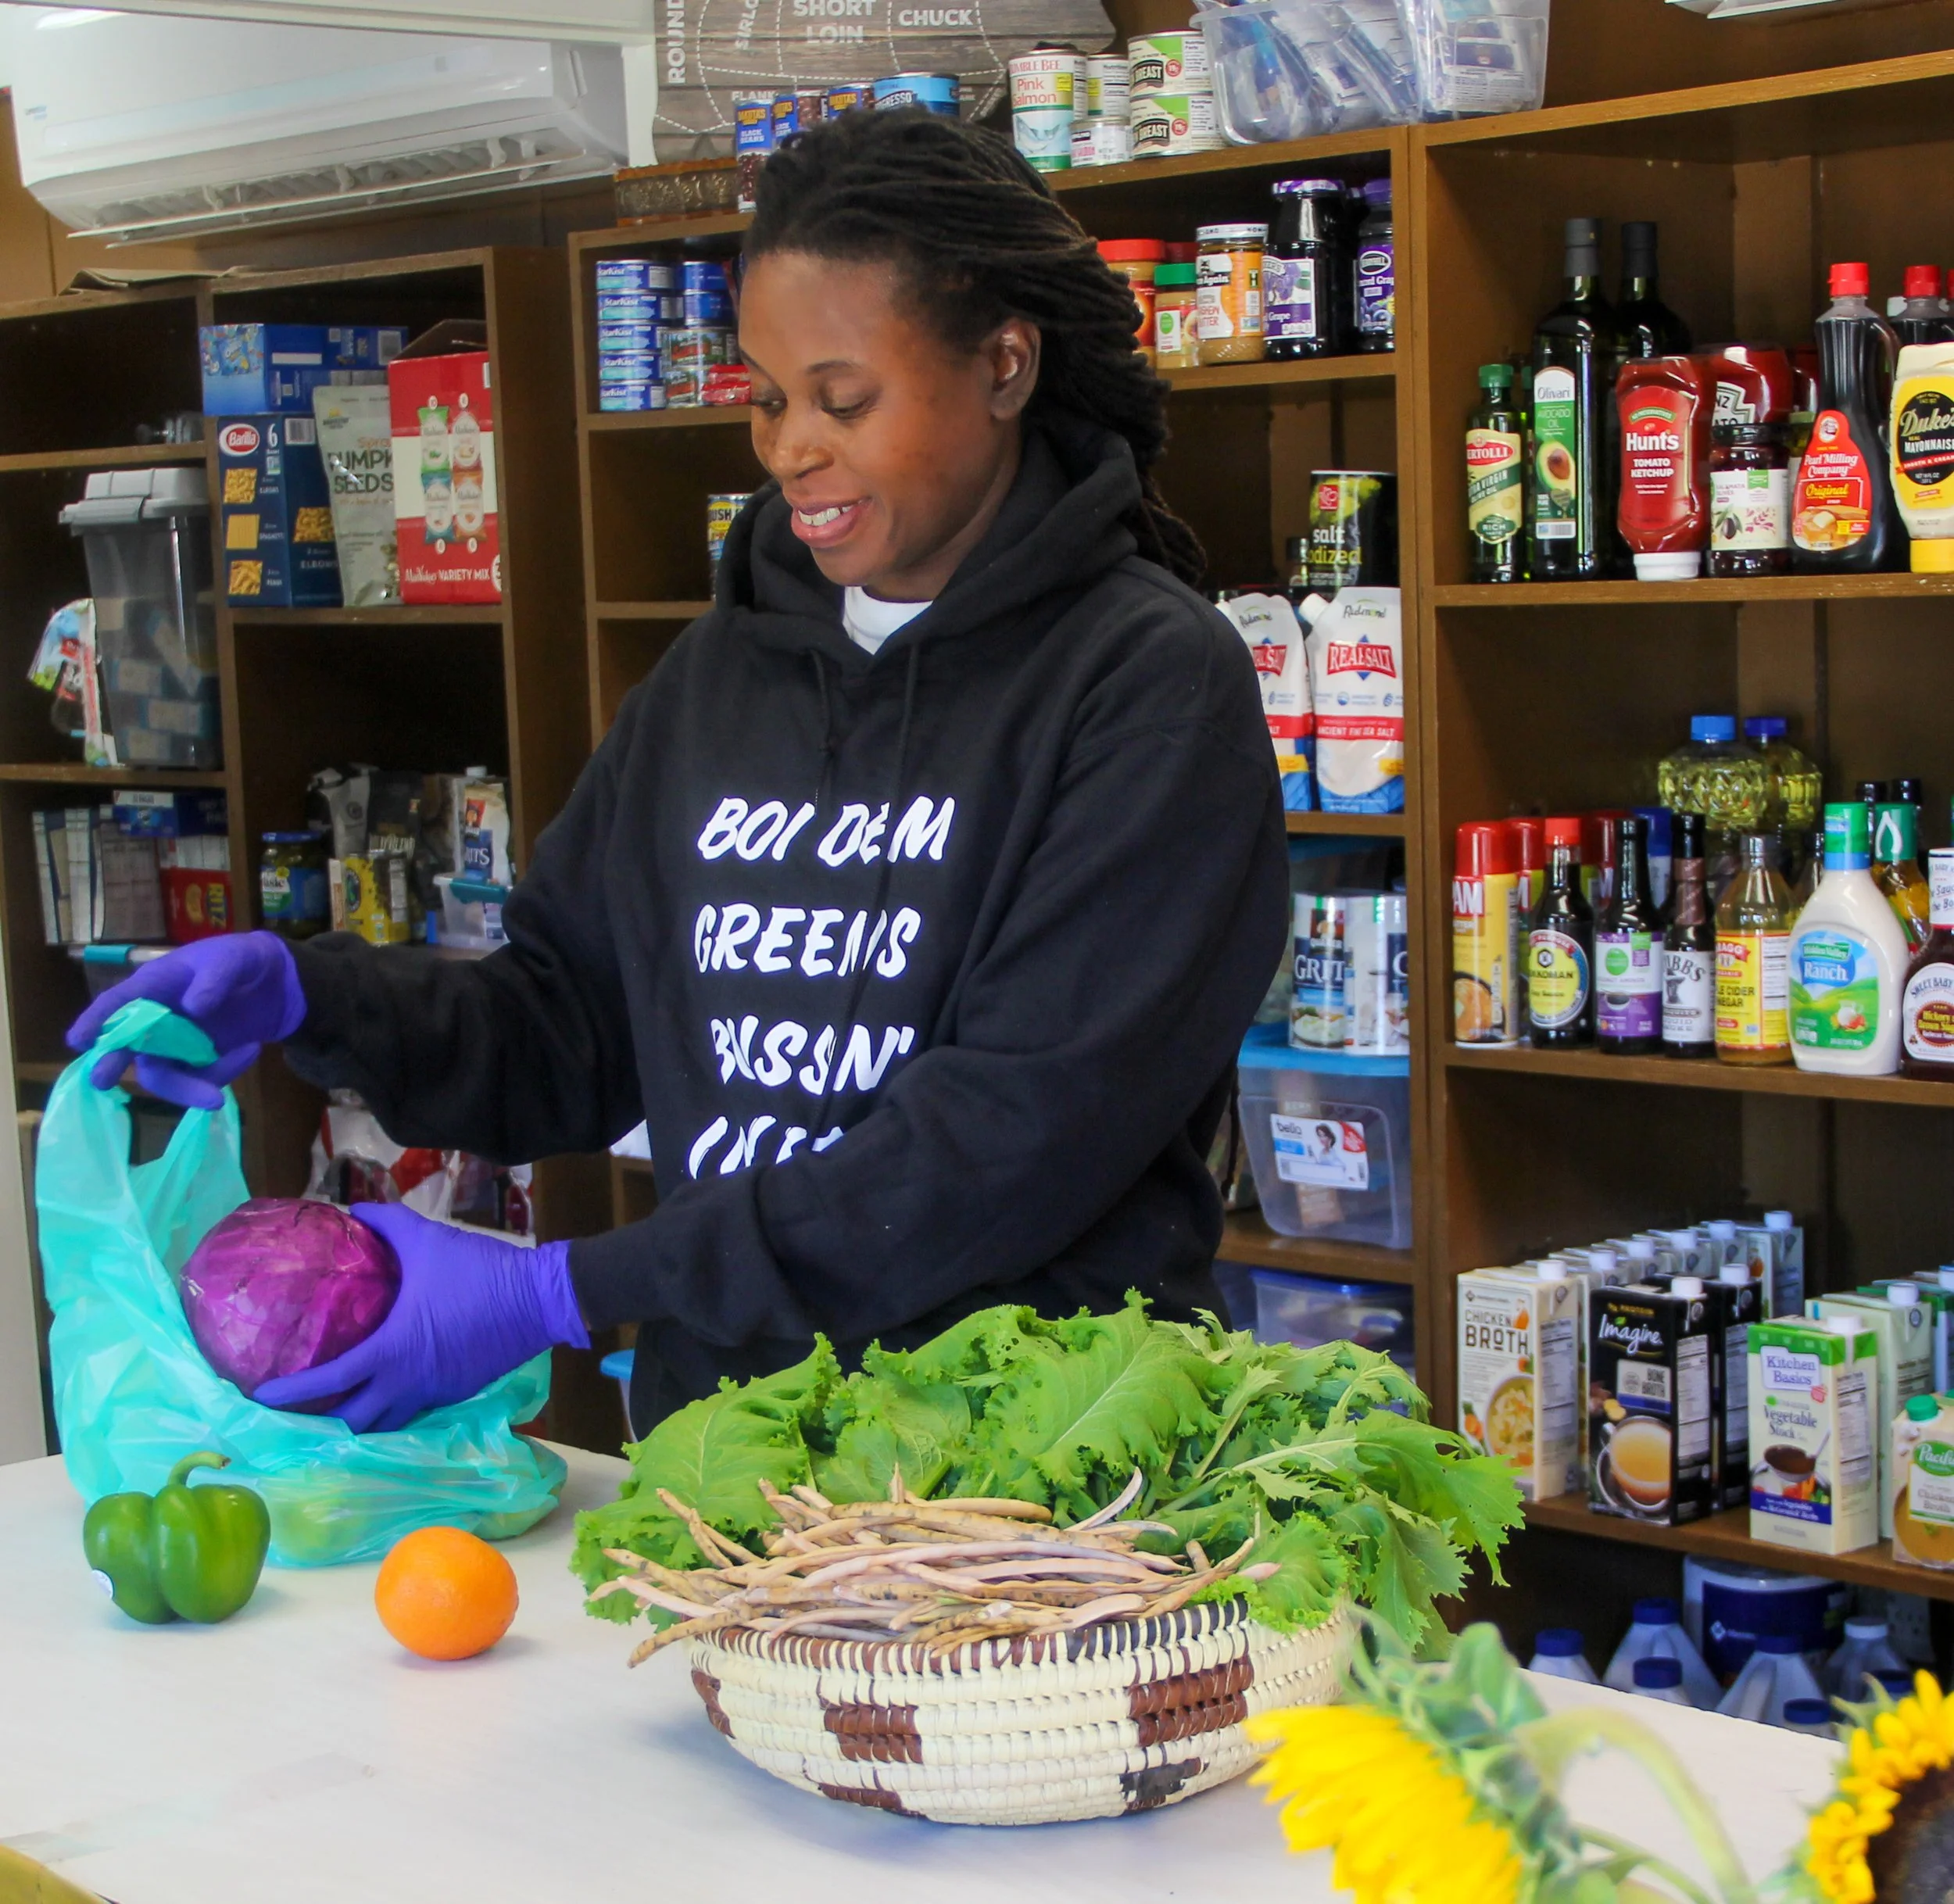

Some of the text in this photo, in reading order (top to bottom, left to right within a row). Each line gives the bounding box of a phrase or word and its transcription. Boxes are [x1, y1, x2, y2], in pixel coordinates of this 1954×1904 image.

[793, 0, 876, 16] SHORT
[898, 9, 975, 27] CHUCK
[807, 25, 864, 44] LOIN
[1041, 59, 1062, 70] BEE
[1017, 77, 1045, 91] Pink
[1012, 91, 1058, 106] Salmon
[604, 296, 640, 307] StarKist
[1268, 311, 1291, 323] Grape
[601, 327, 633, 338] StarKist
[603, 357, 637, 367] StarKist
[1537, 386, 1571, 399] Olivari
[1537, 408, 1571, 418] AVOCADO
[1548, 419, 1559, 429] OIL
[228, 431, 257, 446] Barilla
[267, 424, 278, 448] 6
[1633, 457, 1671, 467] TOMATO
[1804, 453, 1859, 467] Pearl Milling
[1480, 469, 1508, 489] VIRGIN
[1630, 467, 1675, 478] KETCHUP
[1807, 465, 1852, 478] Company
[334, 472, 395, 494] SEEDS
[1805, 483, 1850, 500] Original
[1312, 524, 1346, 544] salt
[1482, 523, 1507, 531] RICH
[438, 567, 473, 582] VARIETY
[474, 567, 491, 581] MIX
[1344, 604, 1387, 619] Redmond
[1317, 725, 1347, 735] ANCIENT
[1377, 726, 1395, 736] SALT
[697, 795, 956, 868] BOI DEM
[208, 882, 227, 929] RITZ
[1452, 880, 1484, 915] AM
[694, 902, 922, 978] GREENS
[1803, 961, 1848, 982] Ranch
[1726, 986, 1755, 997] CIDER
[1909, 976, 1953, 999] SWEET BABY
[1465, 1309, 1512, 1328] CHICKEN
[1466, 1324, 1529, 1355] BROTH
[1598, 1313, 1661, 1356] Imagine
[1766, 1355, 1817, 1371] Kitchen
[1647, 1368, 1666, 1383] BONE
[1773, 1369, 1813, 1386] Basics
[1641, 1381, 1666, 1398] BROTH
[1763, 1405, 1818, 1429] Vegetable
[1769, 1421, 1795, 1439] Stock
